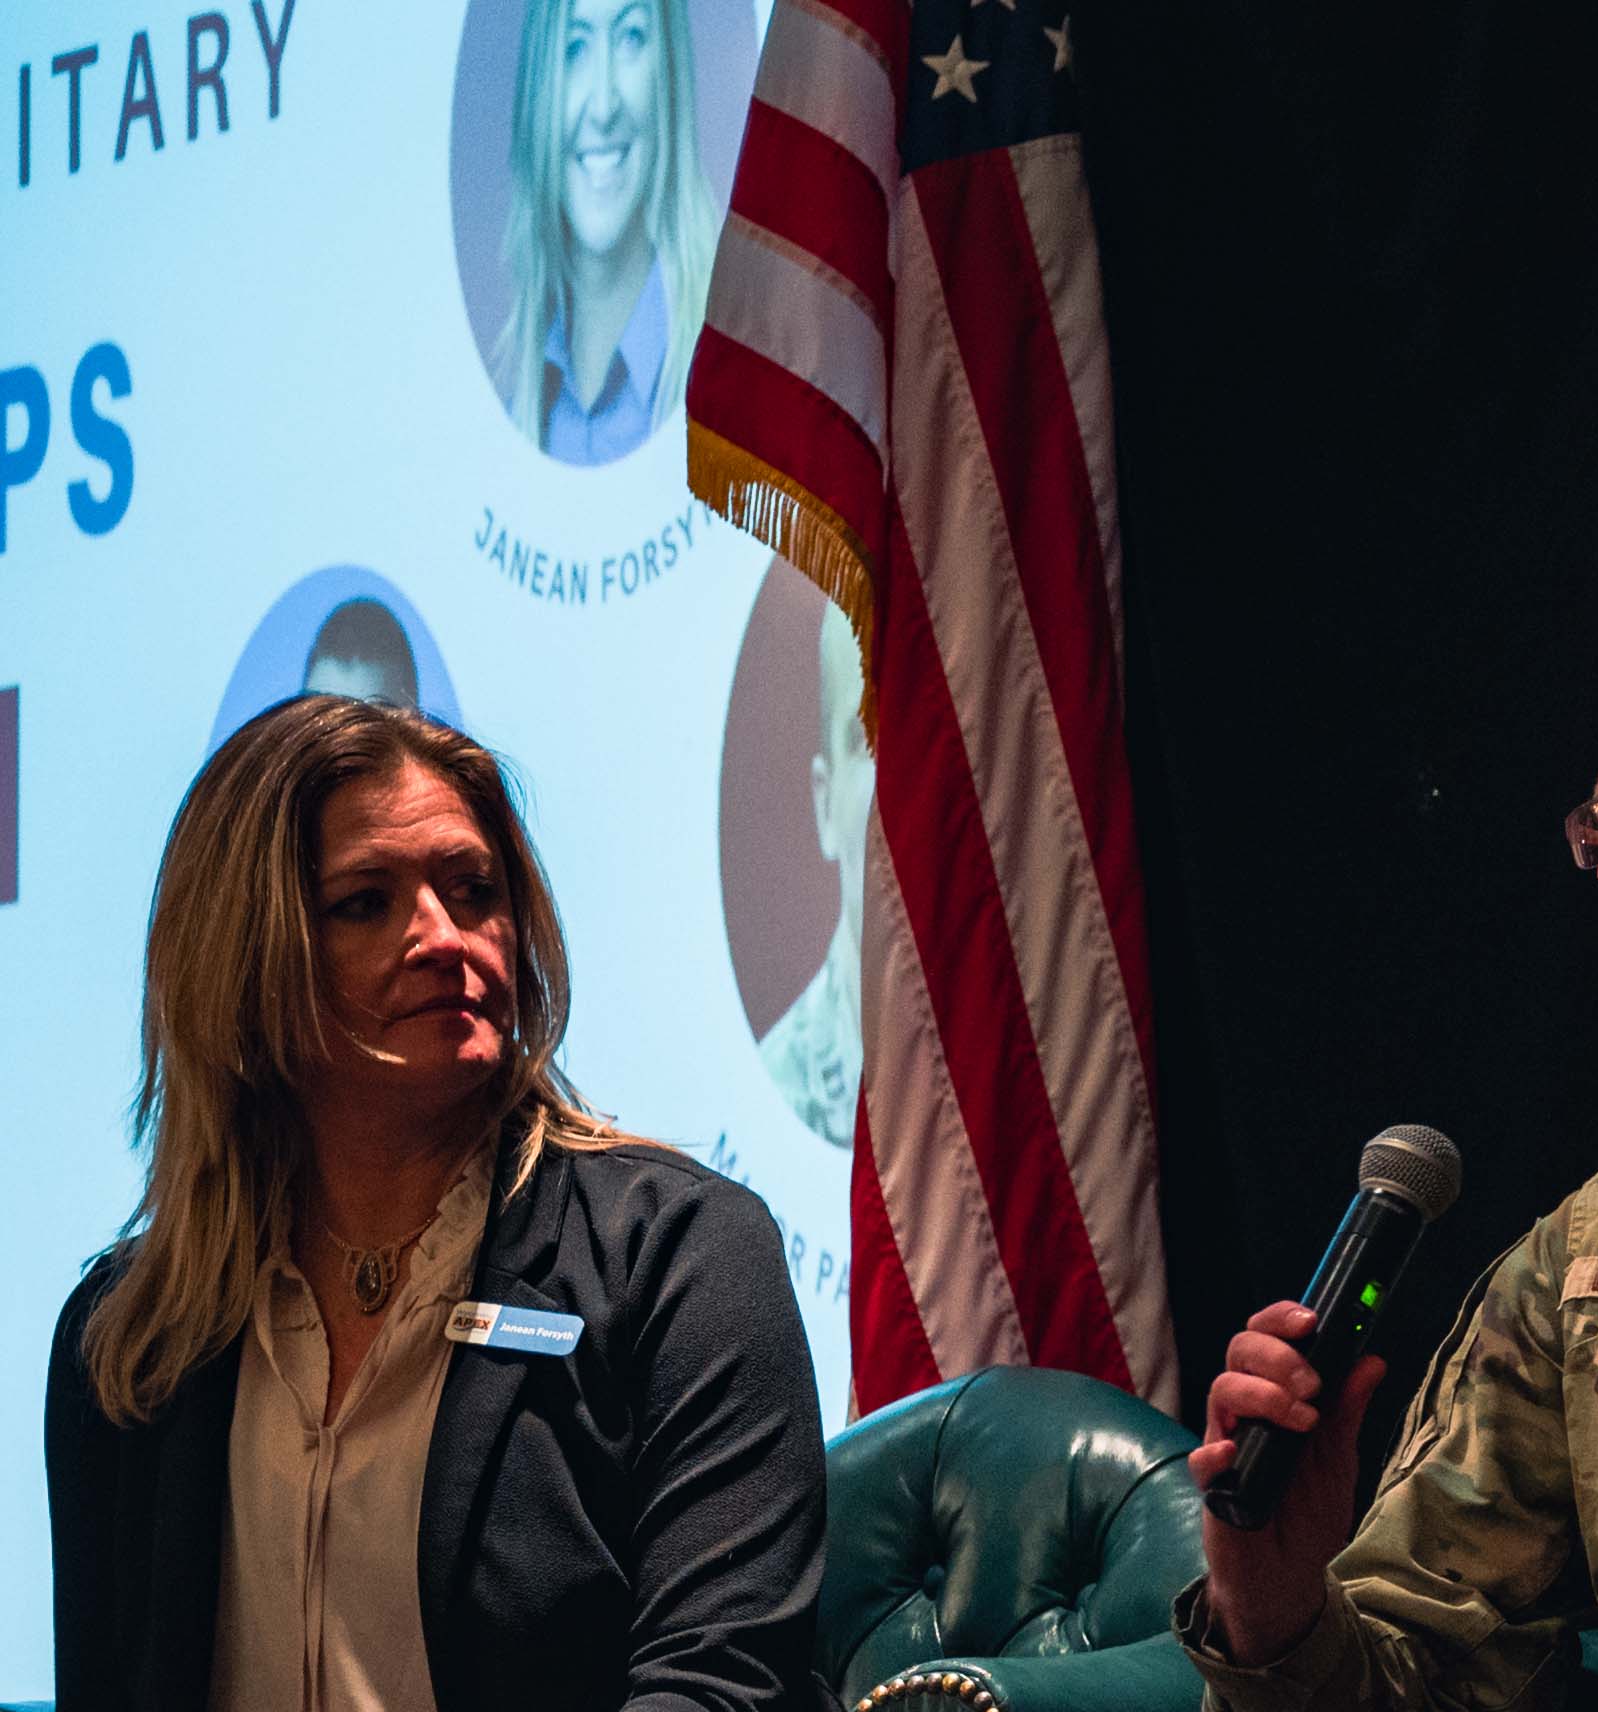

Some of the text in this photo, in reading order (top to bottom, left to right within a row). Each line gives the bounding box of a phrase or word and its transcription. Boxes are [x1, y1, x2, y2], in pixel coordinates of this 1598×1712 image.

[19, 0, 296, 188] ITARY
[0, 340, 135, 556] PS
[474, 505, 588, 604] JANEAN
[453, 1316, 491, 1331] APEX
